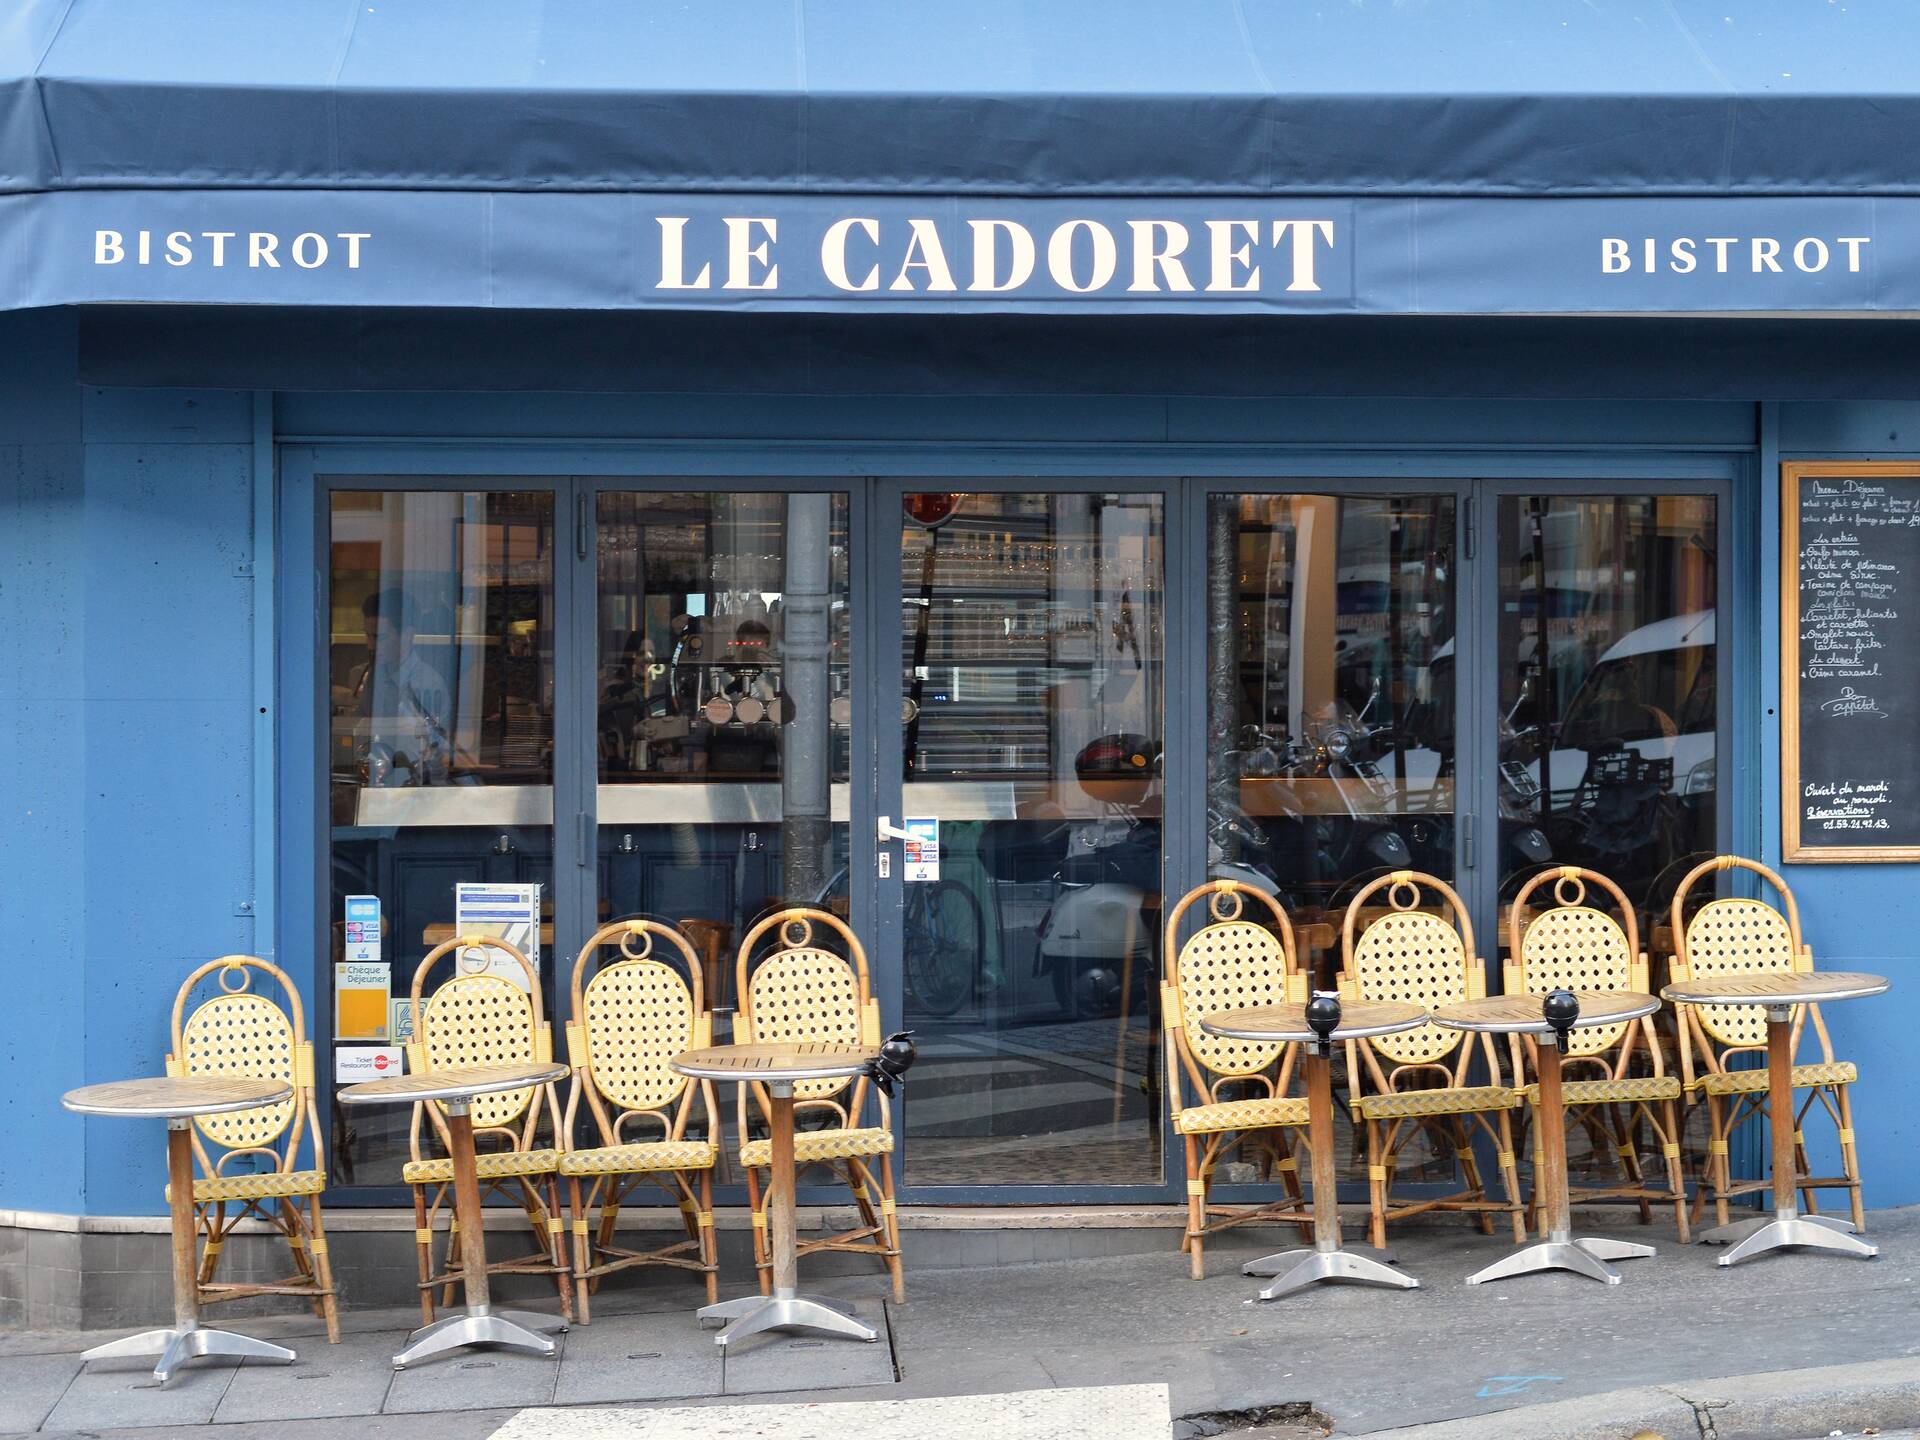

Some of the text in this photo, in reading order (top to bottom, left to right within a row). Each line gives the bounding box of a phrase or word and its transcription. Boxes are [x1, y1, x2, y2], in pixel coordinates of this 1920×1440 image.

[95, 230, 373, 269] BISTROT
[655, 217, 1334, 293] LE CADORET
[1602, 237, 1871, 274] BISTROT
[1833, 797, 1848, 805] au
[1839, 781, 1853, 795] du
[1857, 780, 1890, 793] mardi
